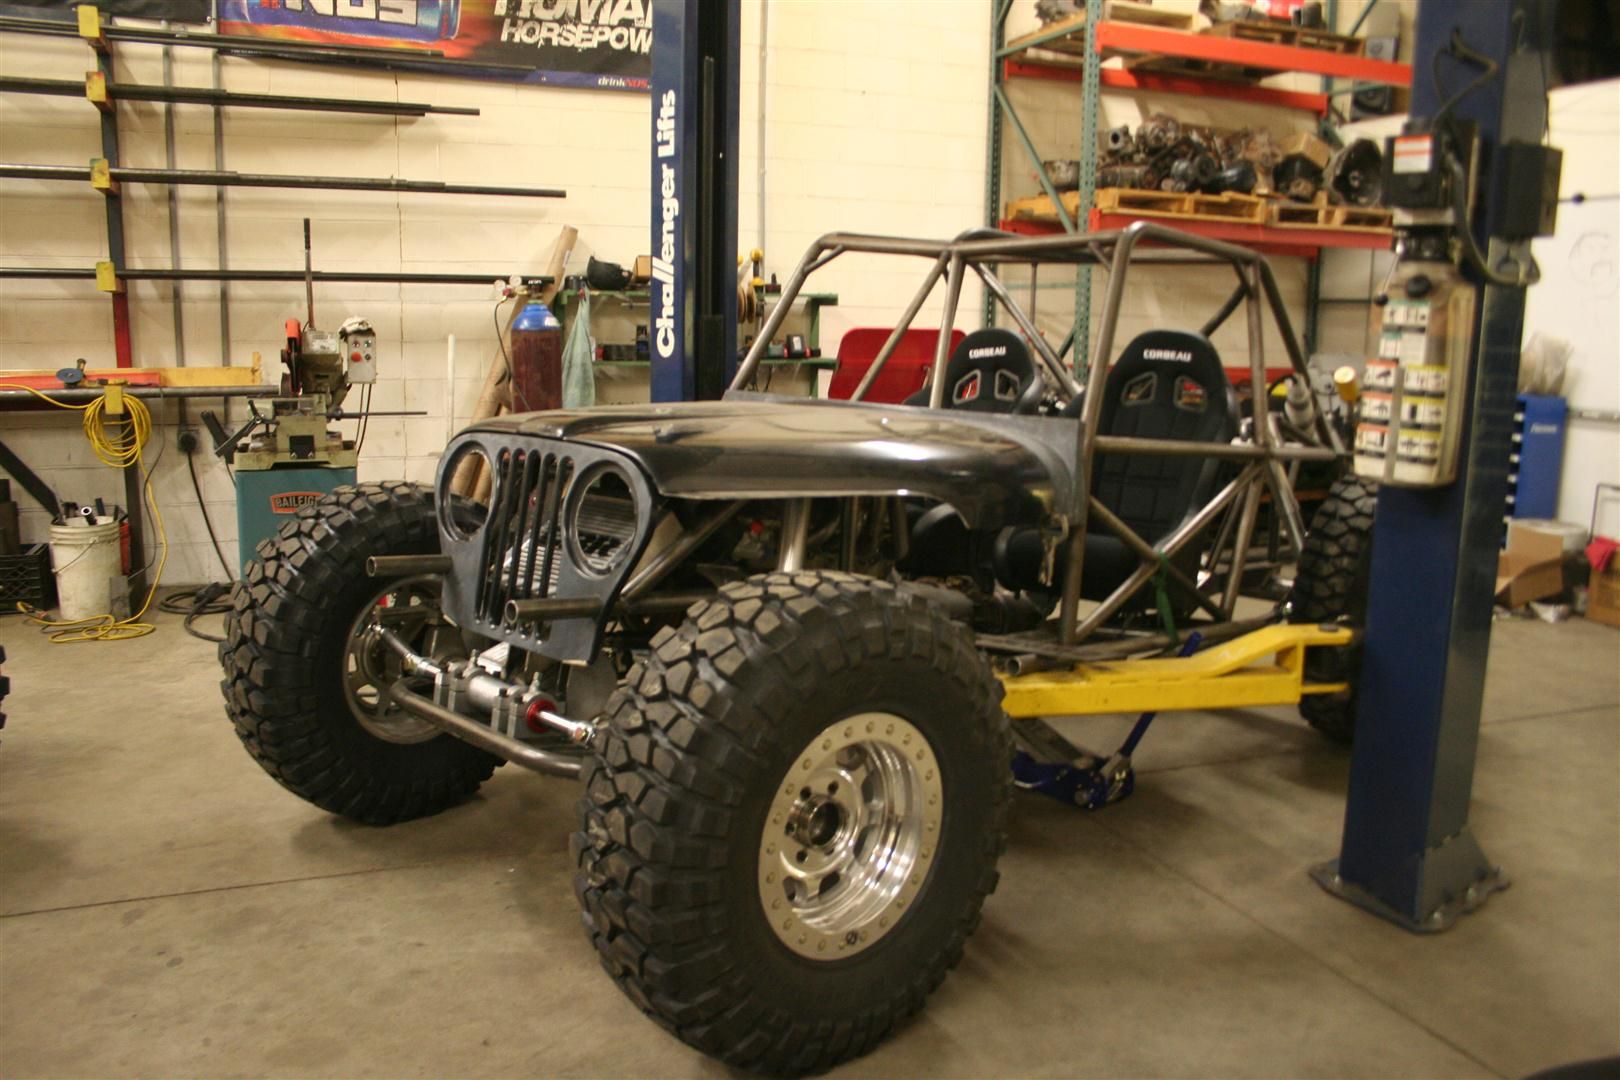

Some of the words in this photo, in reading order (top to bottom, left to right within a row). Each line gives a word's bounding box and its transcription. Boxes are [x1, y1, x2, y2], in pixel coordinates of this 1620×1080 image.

[657, 89, 676, 158] Lifts
[652, 163, 679, 358] Challenger
[968, 345, 1006, 359] CORBEAU
[1143, 348, 1192, 362] CORBEAU
